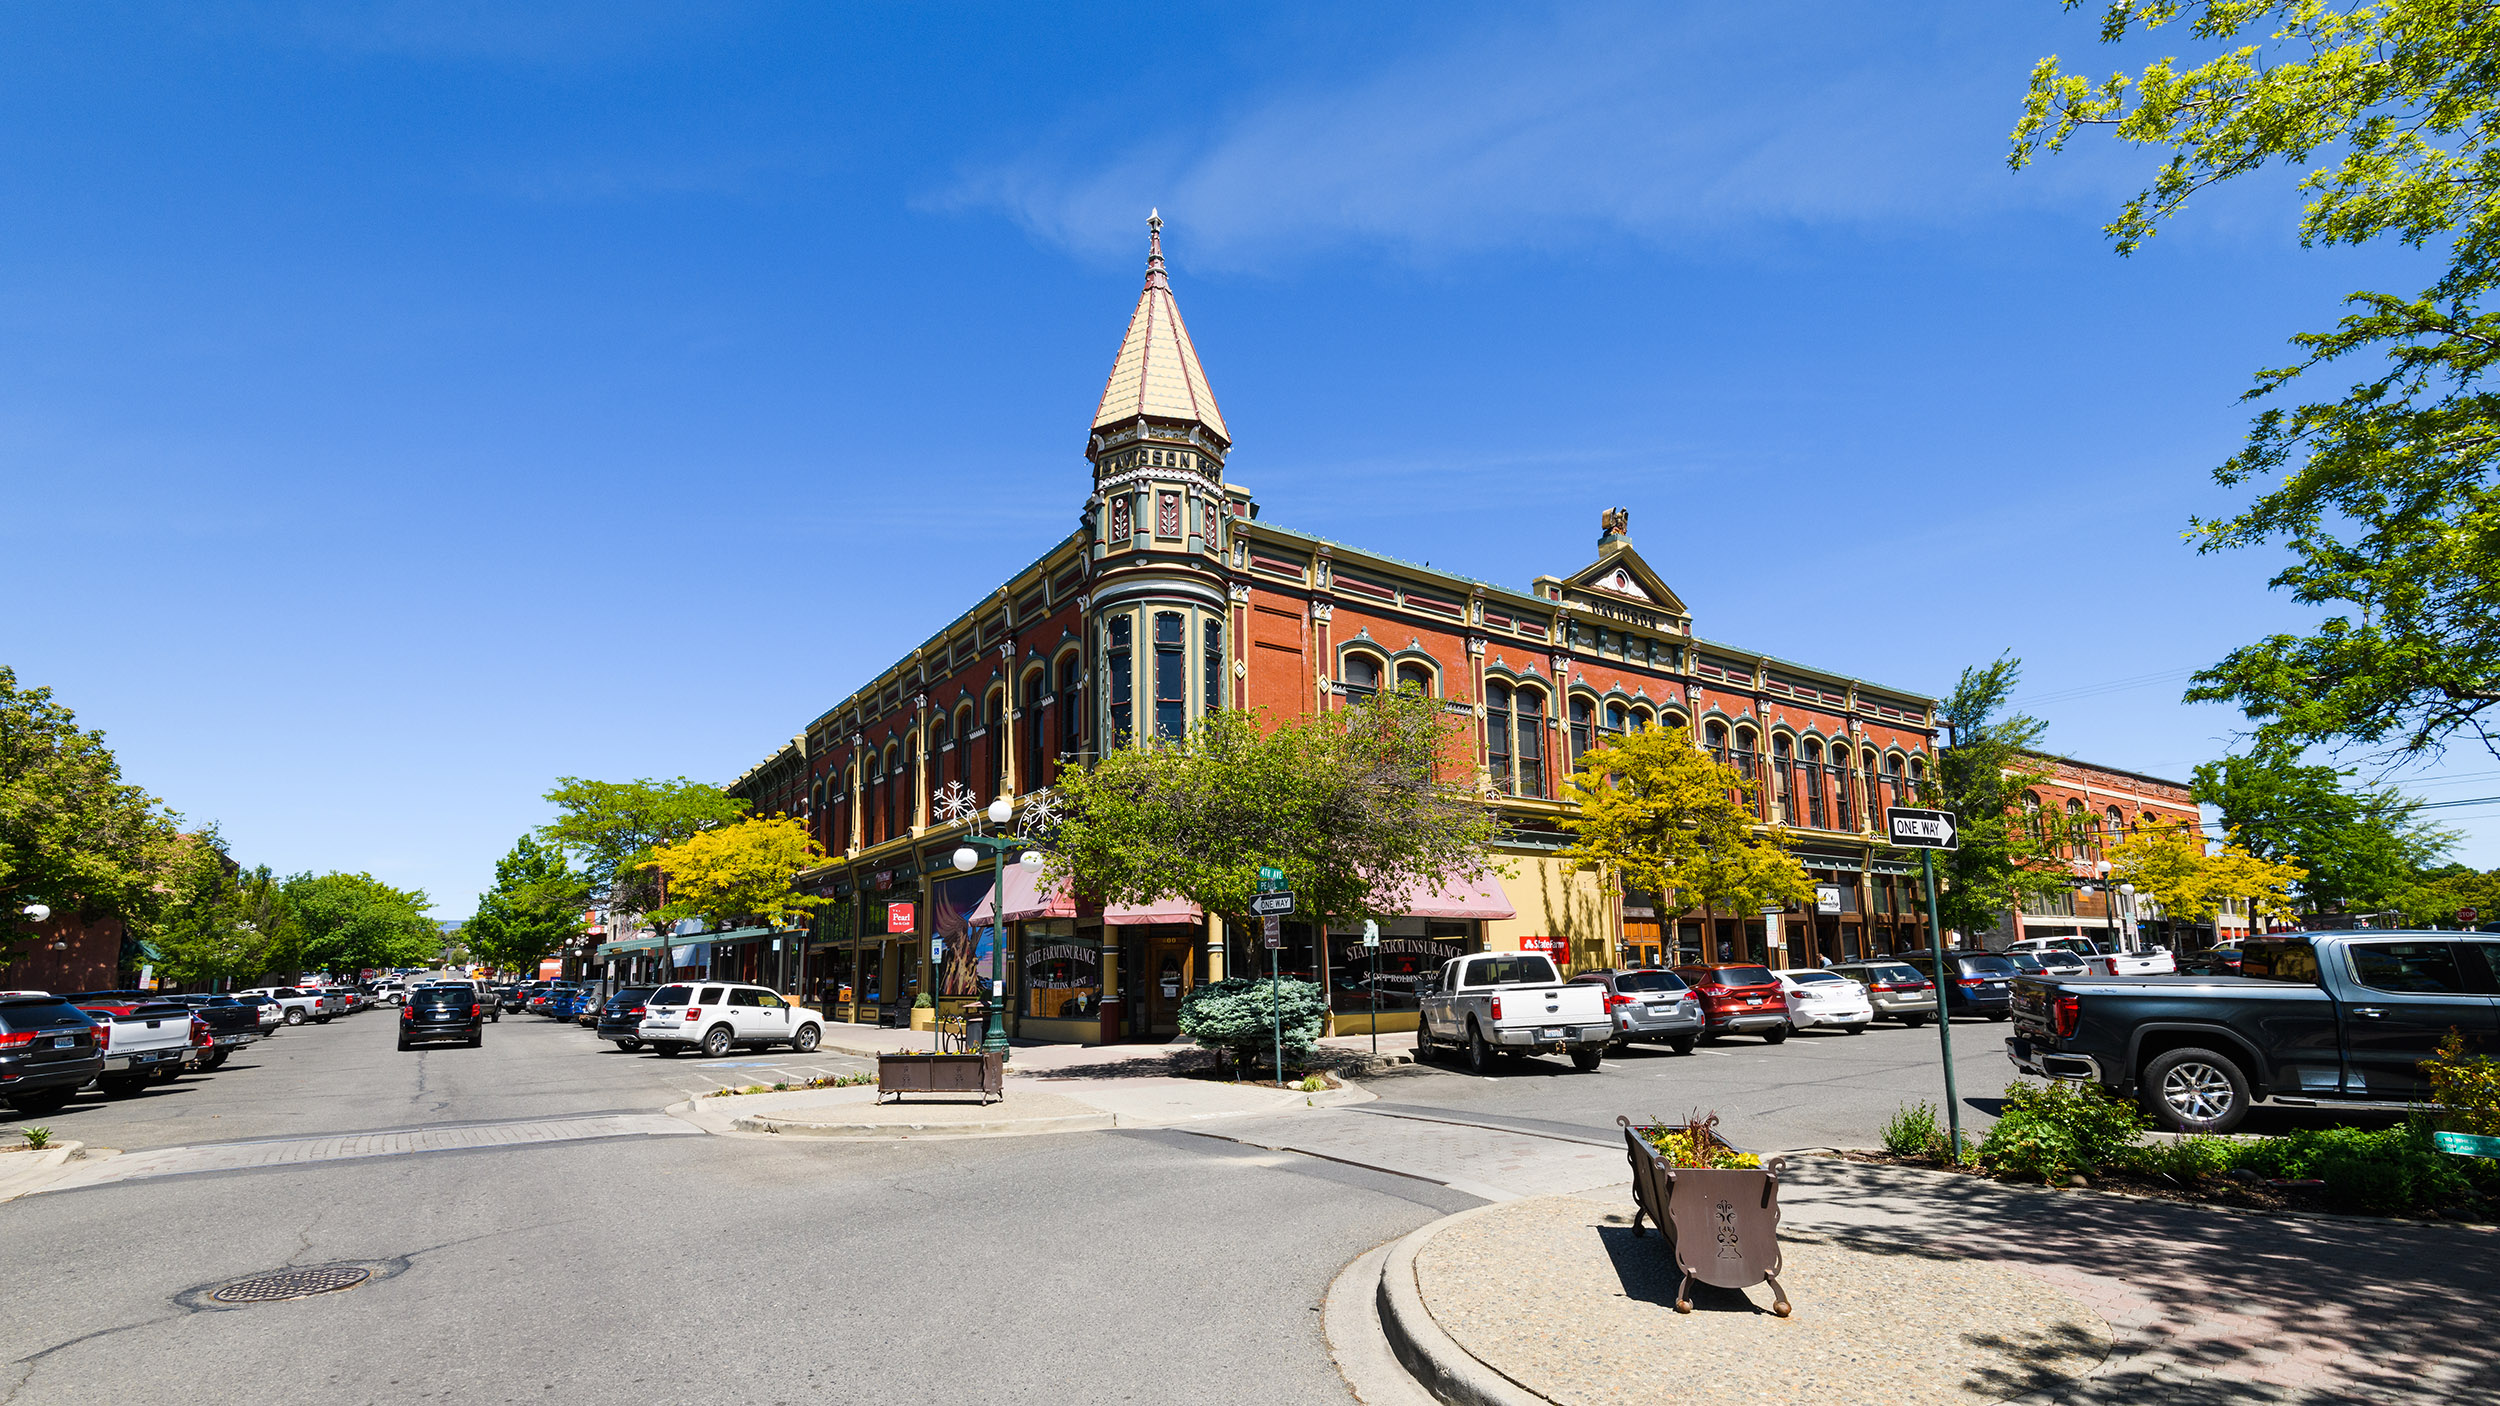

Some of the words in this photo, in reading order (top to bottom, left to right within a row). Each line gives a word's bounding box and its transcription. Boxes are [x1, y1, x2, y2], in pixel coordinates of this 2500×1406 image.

[1103, 448, 1190, 472] DAVIDSON
[1197, 455, 1220, 480] 1889
[1592, 602, 1657, 629] DAVIDSON
[1897, 820, 1918, 835] ONE
[1921, 821, 1939, 836] WAY
[1261, 868, 1271, 877] 4TH
[1273, 871, 1282, 879] AVE
[1261, 901, 1274, 910] ONE
[1275, 899, 1289, 908] WAY
[893, 913, 911, 921] Pearl
[1025, 949, 1042, 968] STATE
[1042, 945, 1060, 961] FARM
[1060, 944, 1096, 966] INSURANCE
[1379, 940, 1405, 954] FARM
[1407, 939, 1462, 958] INSURANCE
